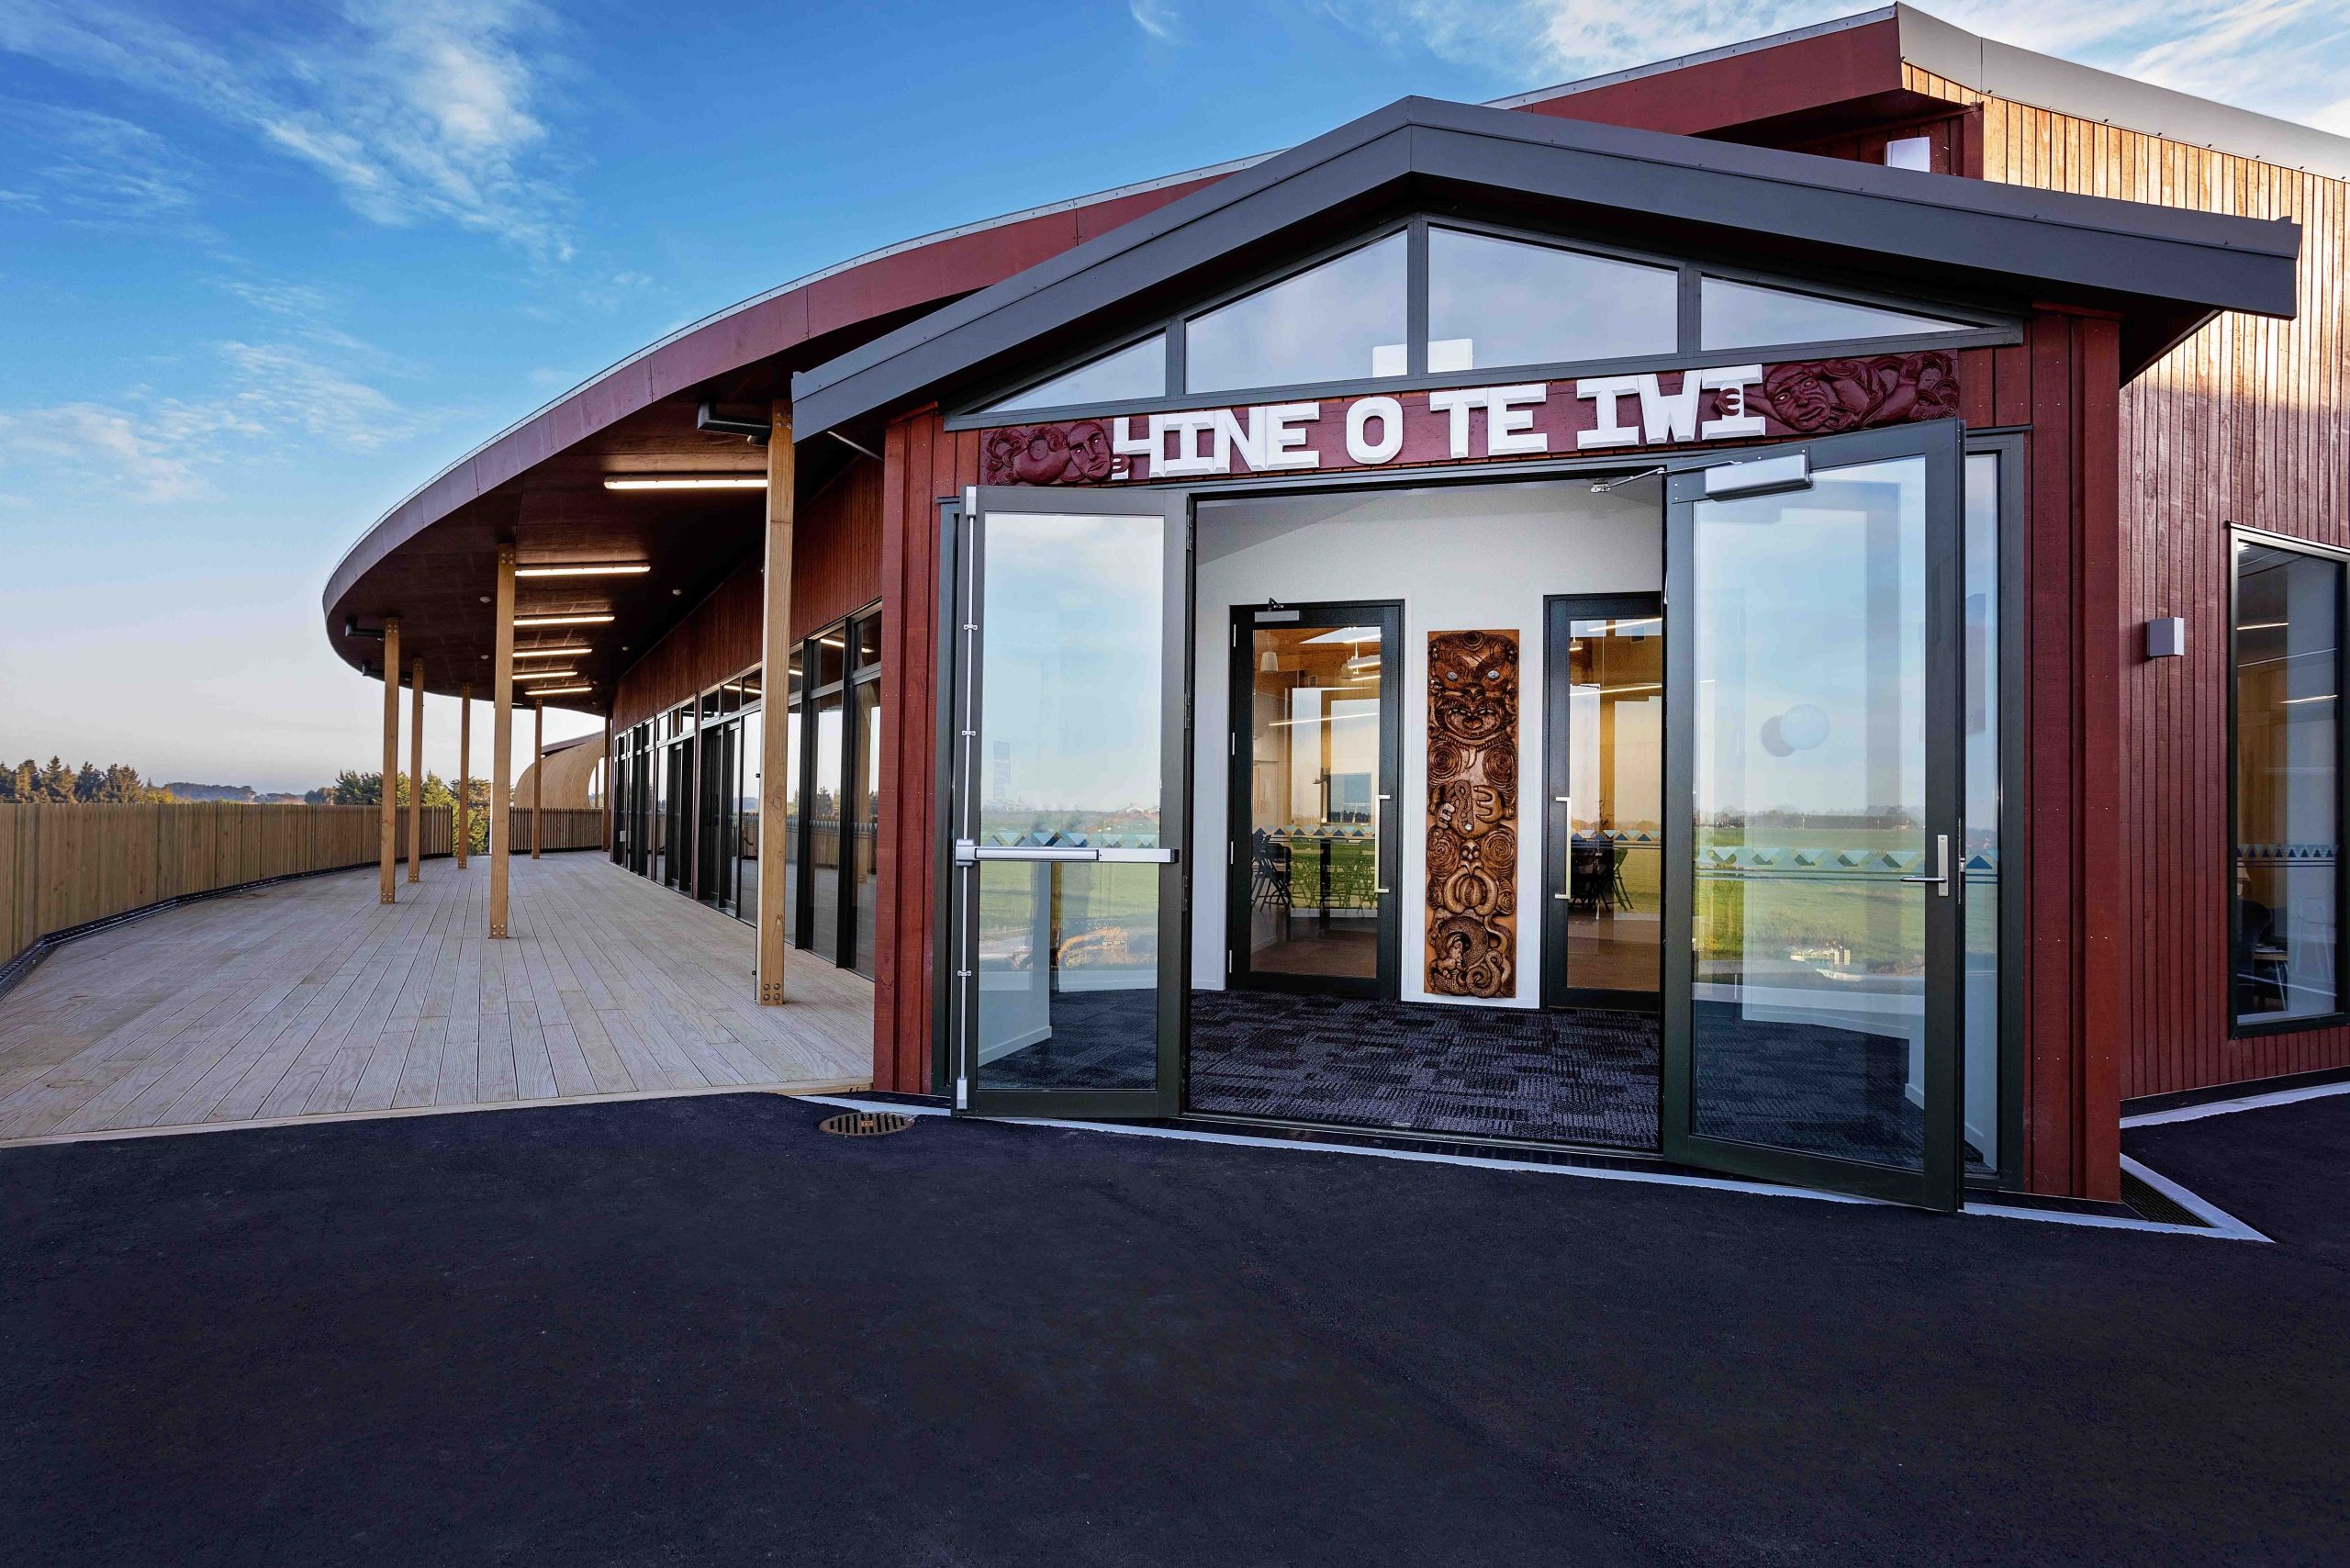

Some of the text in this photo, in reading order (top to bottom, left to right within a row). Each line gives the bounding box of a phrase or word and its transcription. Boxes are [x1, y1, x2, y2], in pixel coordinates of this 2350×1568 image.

[1112, 364, 1766, 480] HINE O TE IWI
